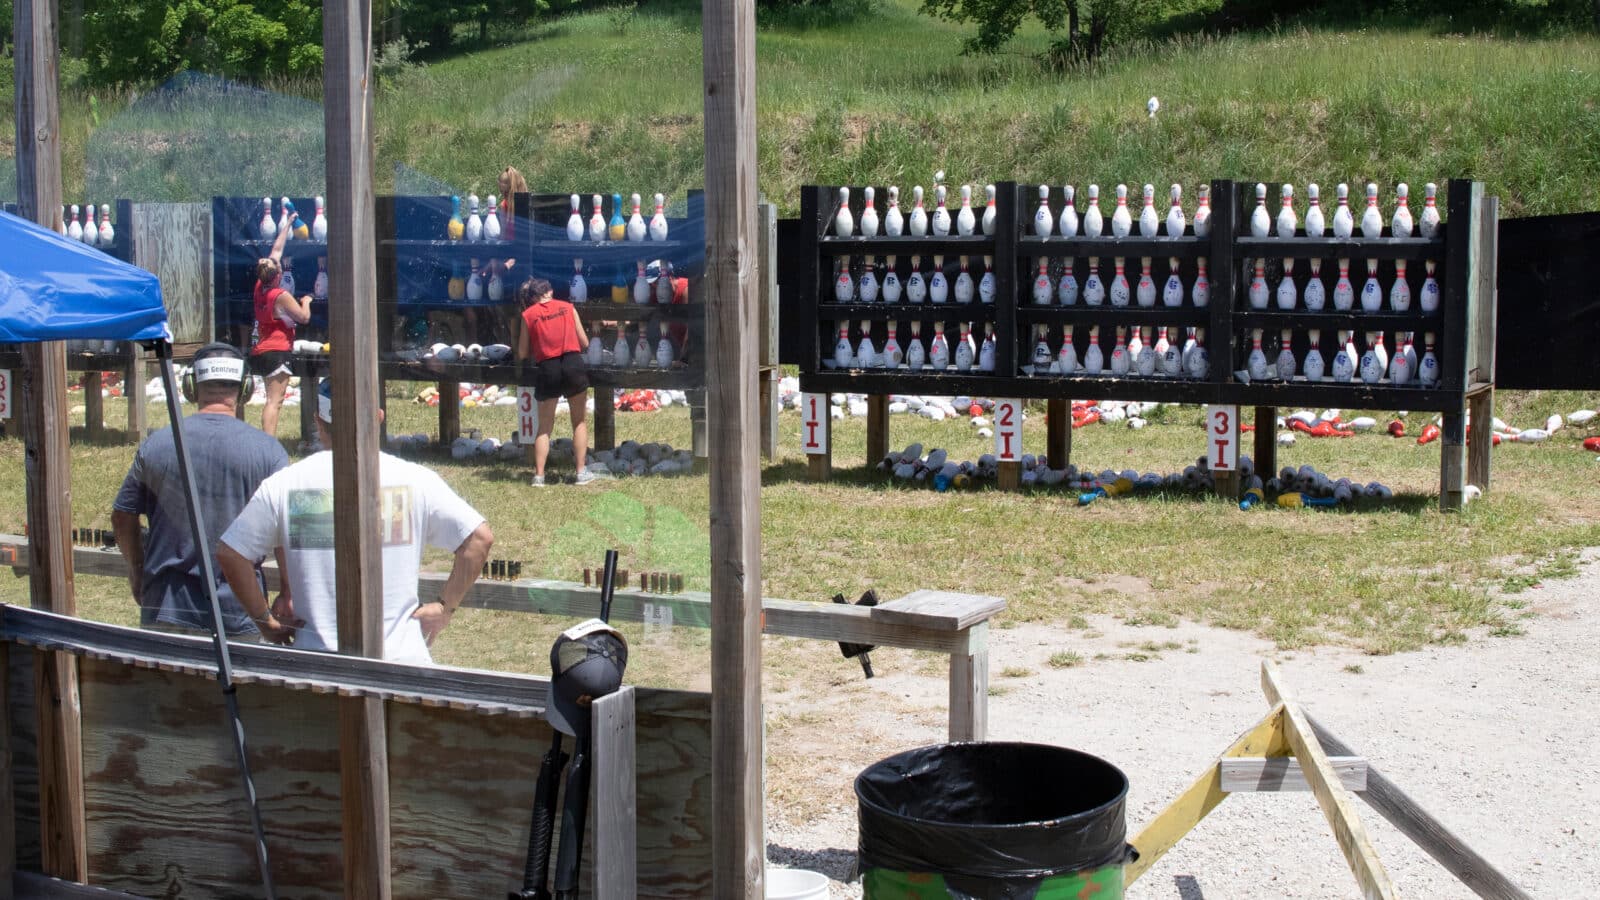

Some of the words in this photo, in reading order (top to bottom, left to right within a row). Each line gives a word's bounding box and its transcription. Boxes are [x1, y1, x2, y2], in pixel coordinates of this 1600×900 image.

[521, 392, 531, 412] 3
[1000, 403, 1013, 426] 2
[1214, 411, 1229, 435] 3
[522, 415, 533, 437] H
